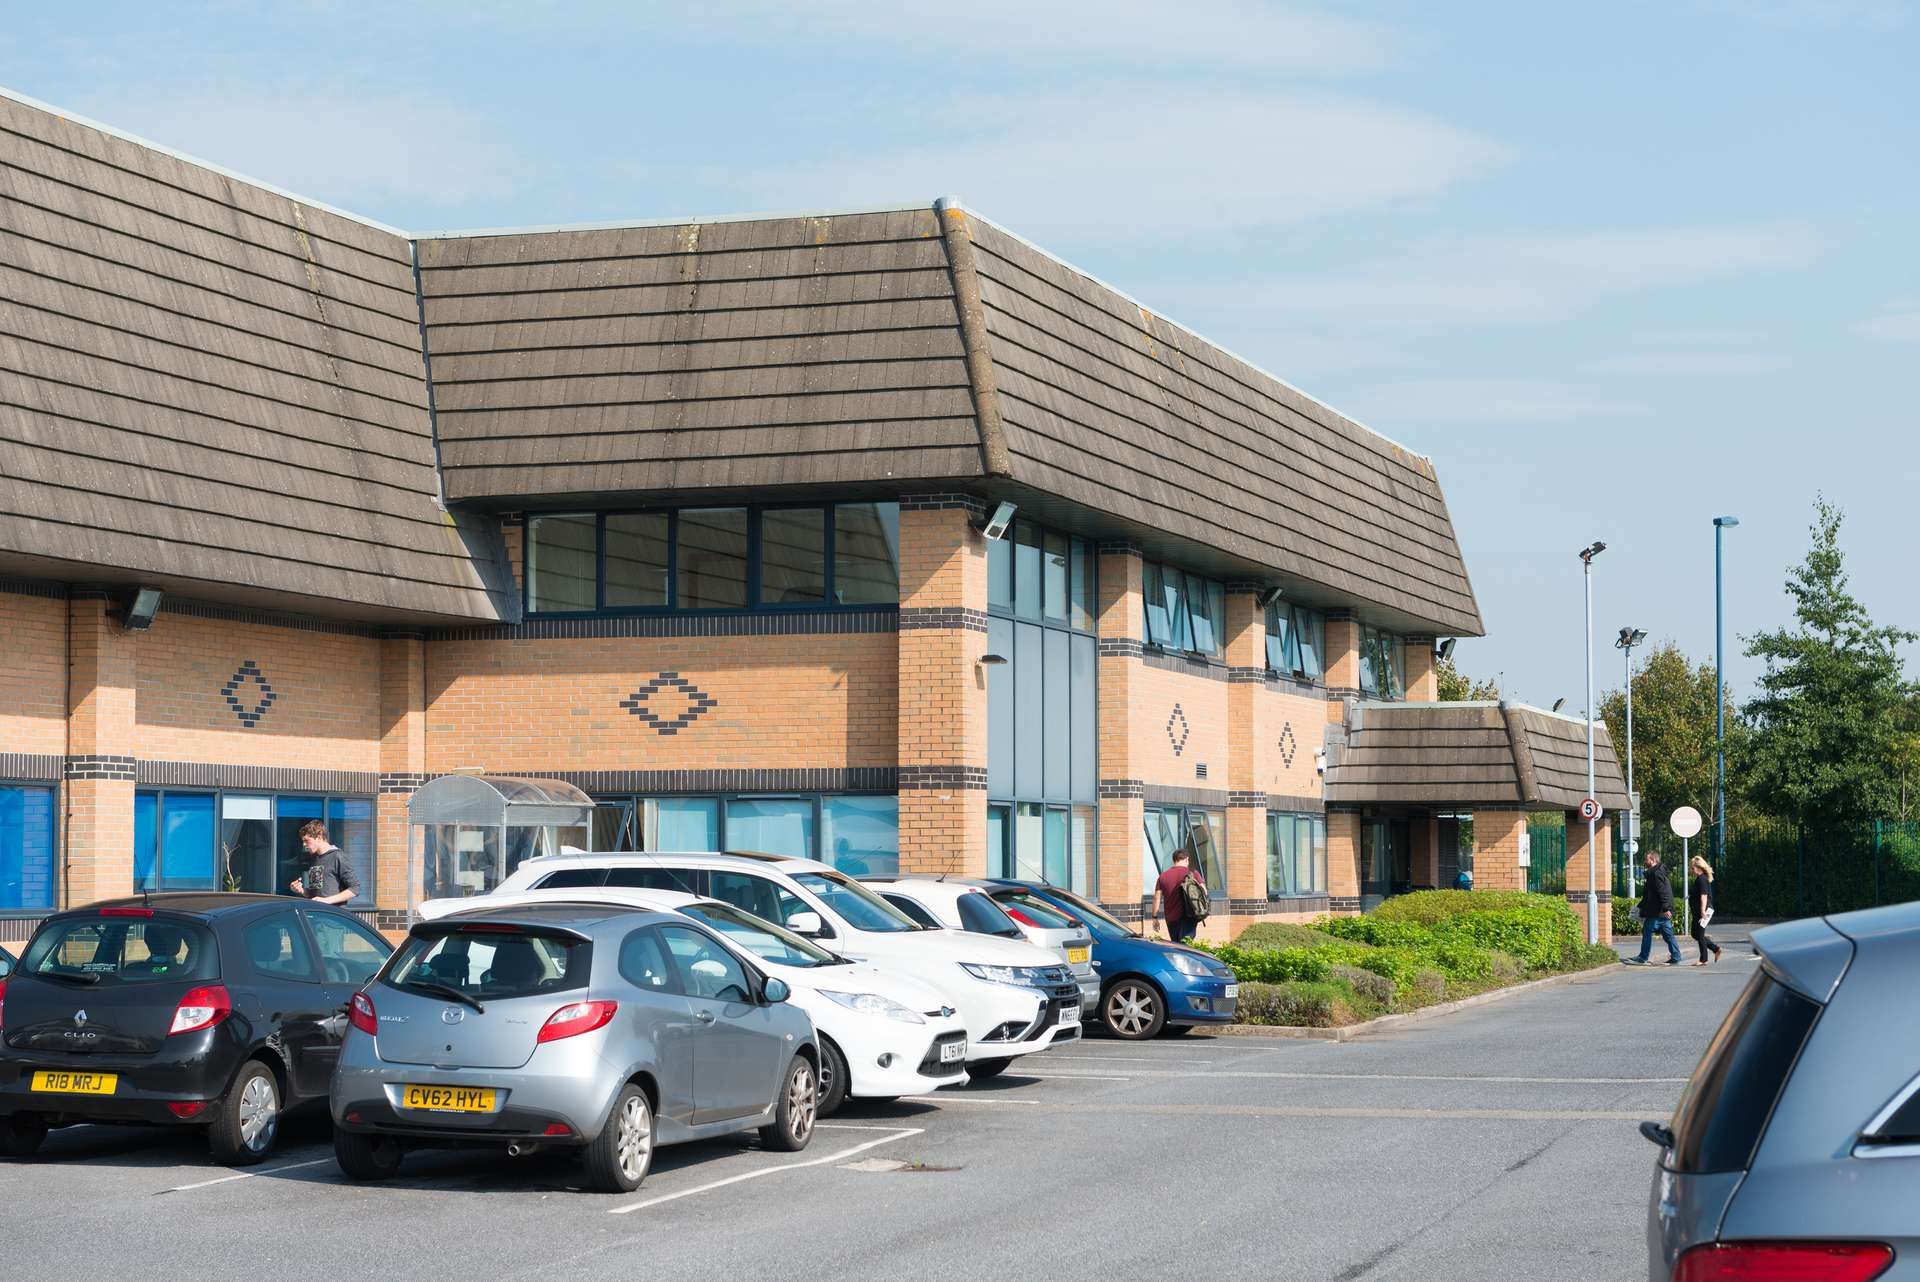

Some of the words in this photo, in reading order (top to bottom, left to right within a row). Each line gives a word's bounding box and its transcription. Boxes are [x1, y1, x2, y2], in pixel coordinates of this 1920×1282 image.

[1585, 803, 1592, 815] 5
[63, 1031, 96, 1039] CLIO
[45, 1073, 70, 1089] R18
[71, 1075, 103, 1090] MRJ
[410, 1088, 453, 1106] CV62
[456, 1090, 488, 1109] HYL
